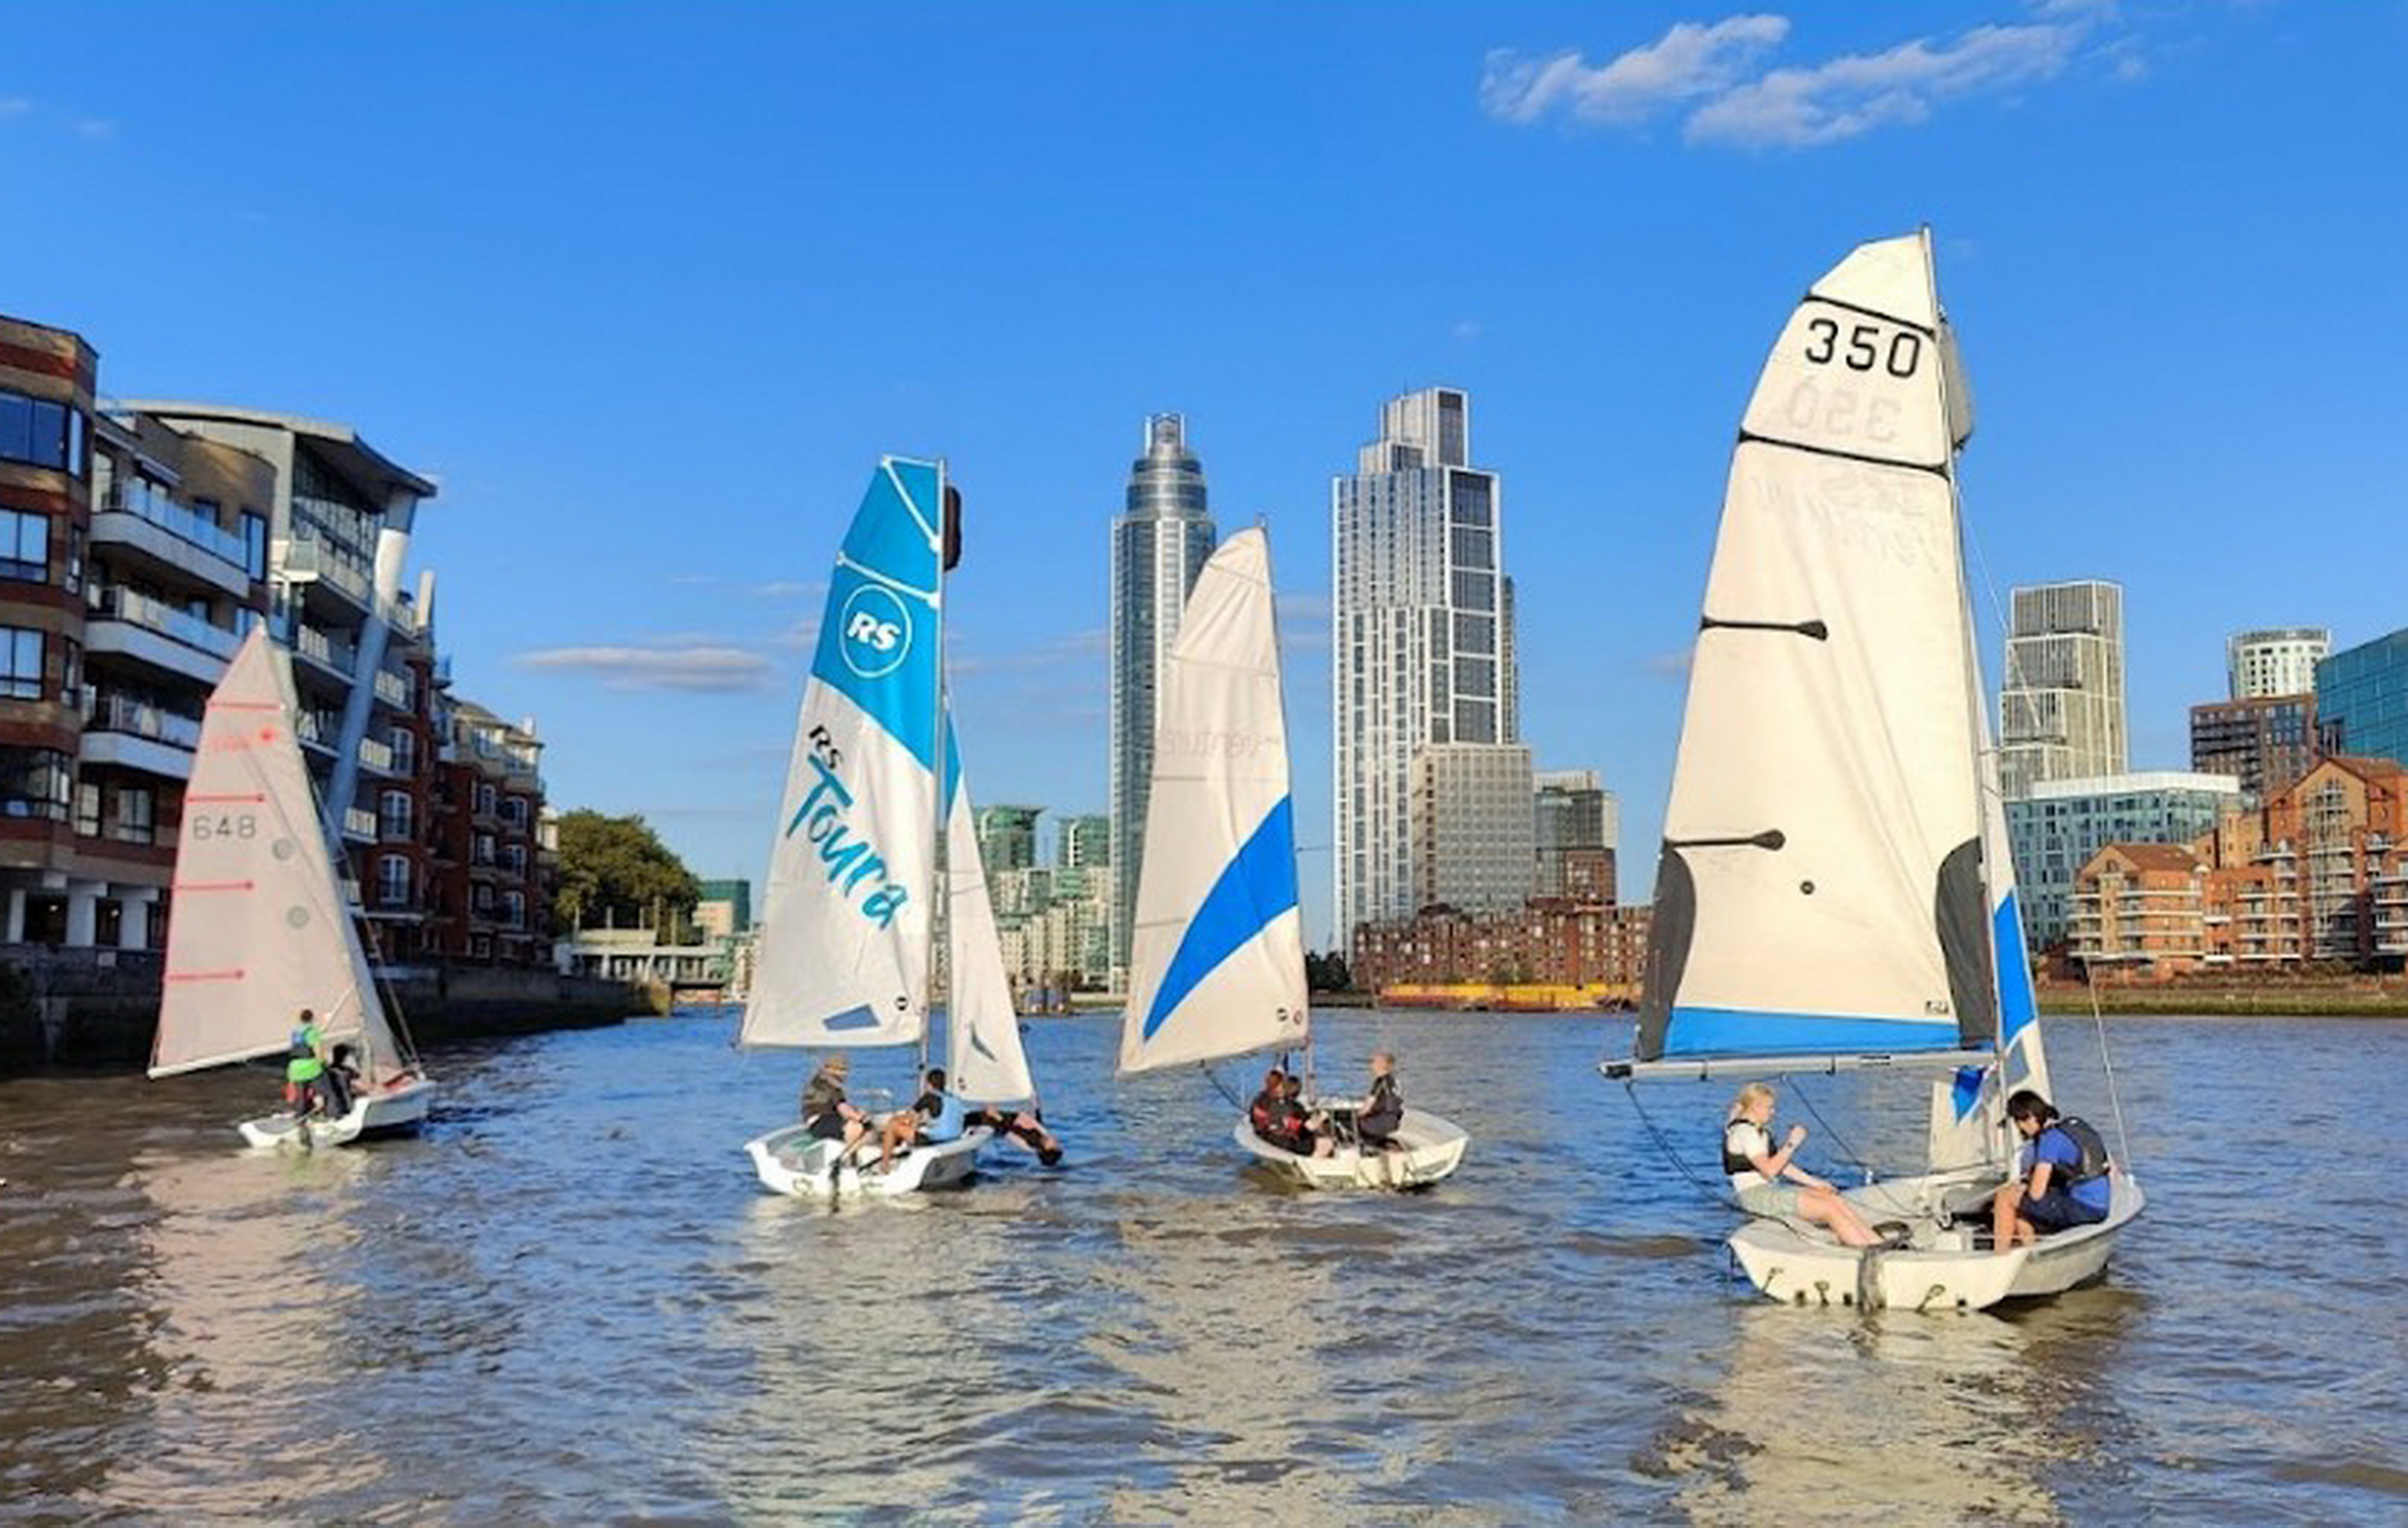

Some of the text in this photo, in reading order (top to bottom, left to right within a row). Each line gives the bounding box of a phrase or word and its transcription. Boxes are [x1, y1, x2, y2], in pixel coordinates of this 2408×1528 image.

[1805, 318, 1921, 378] 350
[847, 611, 901, 651] RS
[808, 725, 843, 769] RS
[193, 814, 256, 840] 648
[786, 752, 908, 931] Toura
